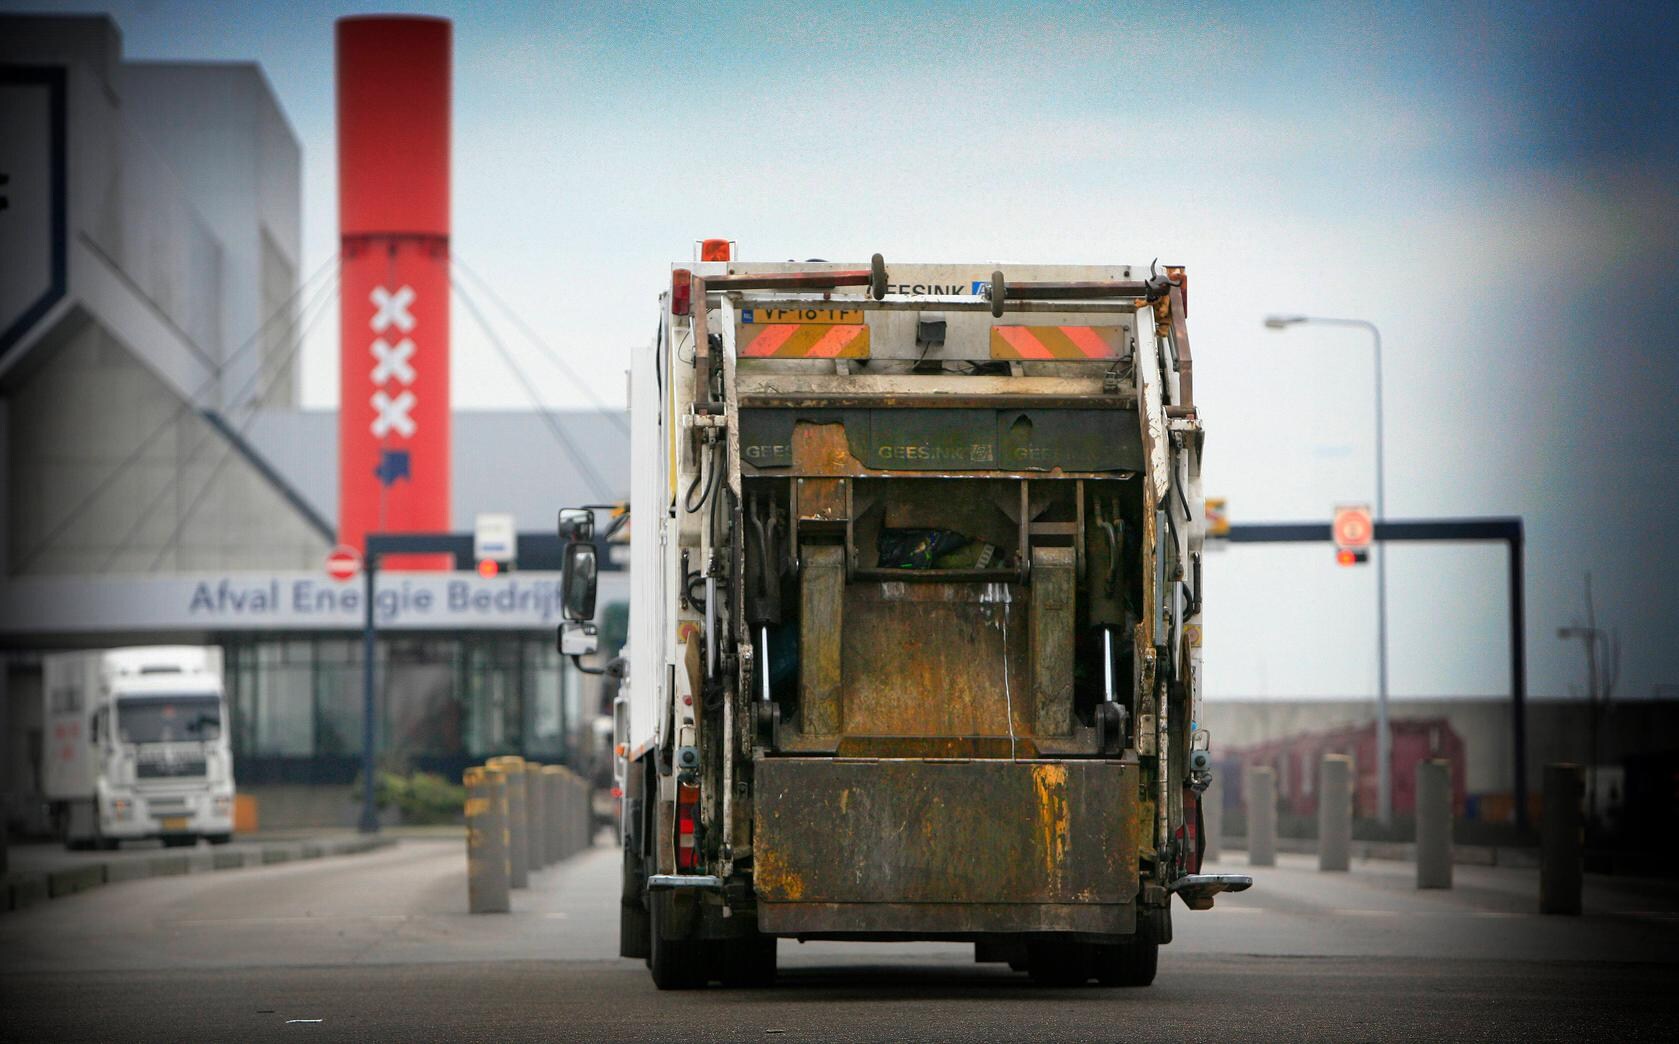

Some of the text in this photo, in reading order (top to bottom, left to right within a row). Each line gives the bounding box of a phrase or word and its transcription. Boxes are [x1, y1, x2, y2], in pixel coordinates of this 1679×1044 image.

[867, 284, 966, 296] EESINK
[190, 579, 279, 613] Afval
[293, 580, 432, 622] Enegie
